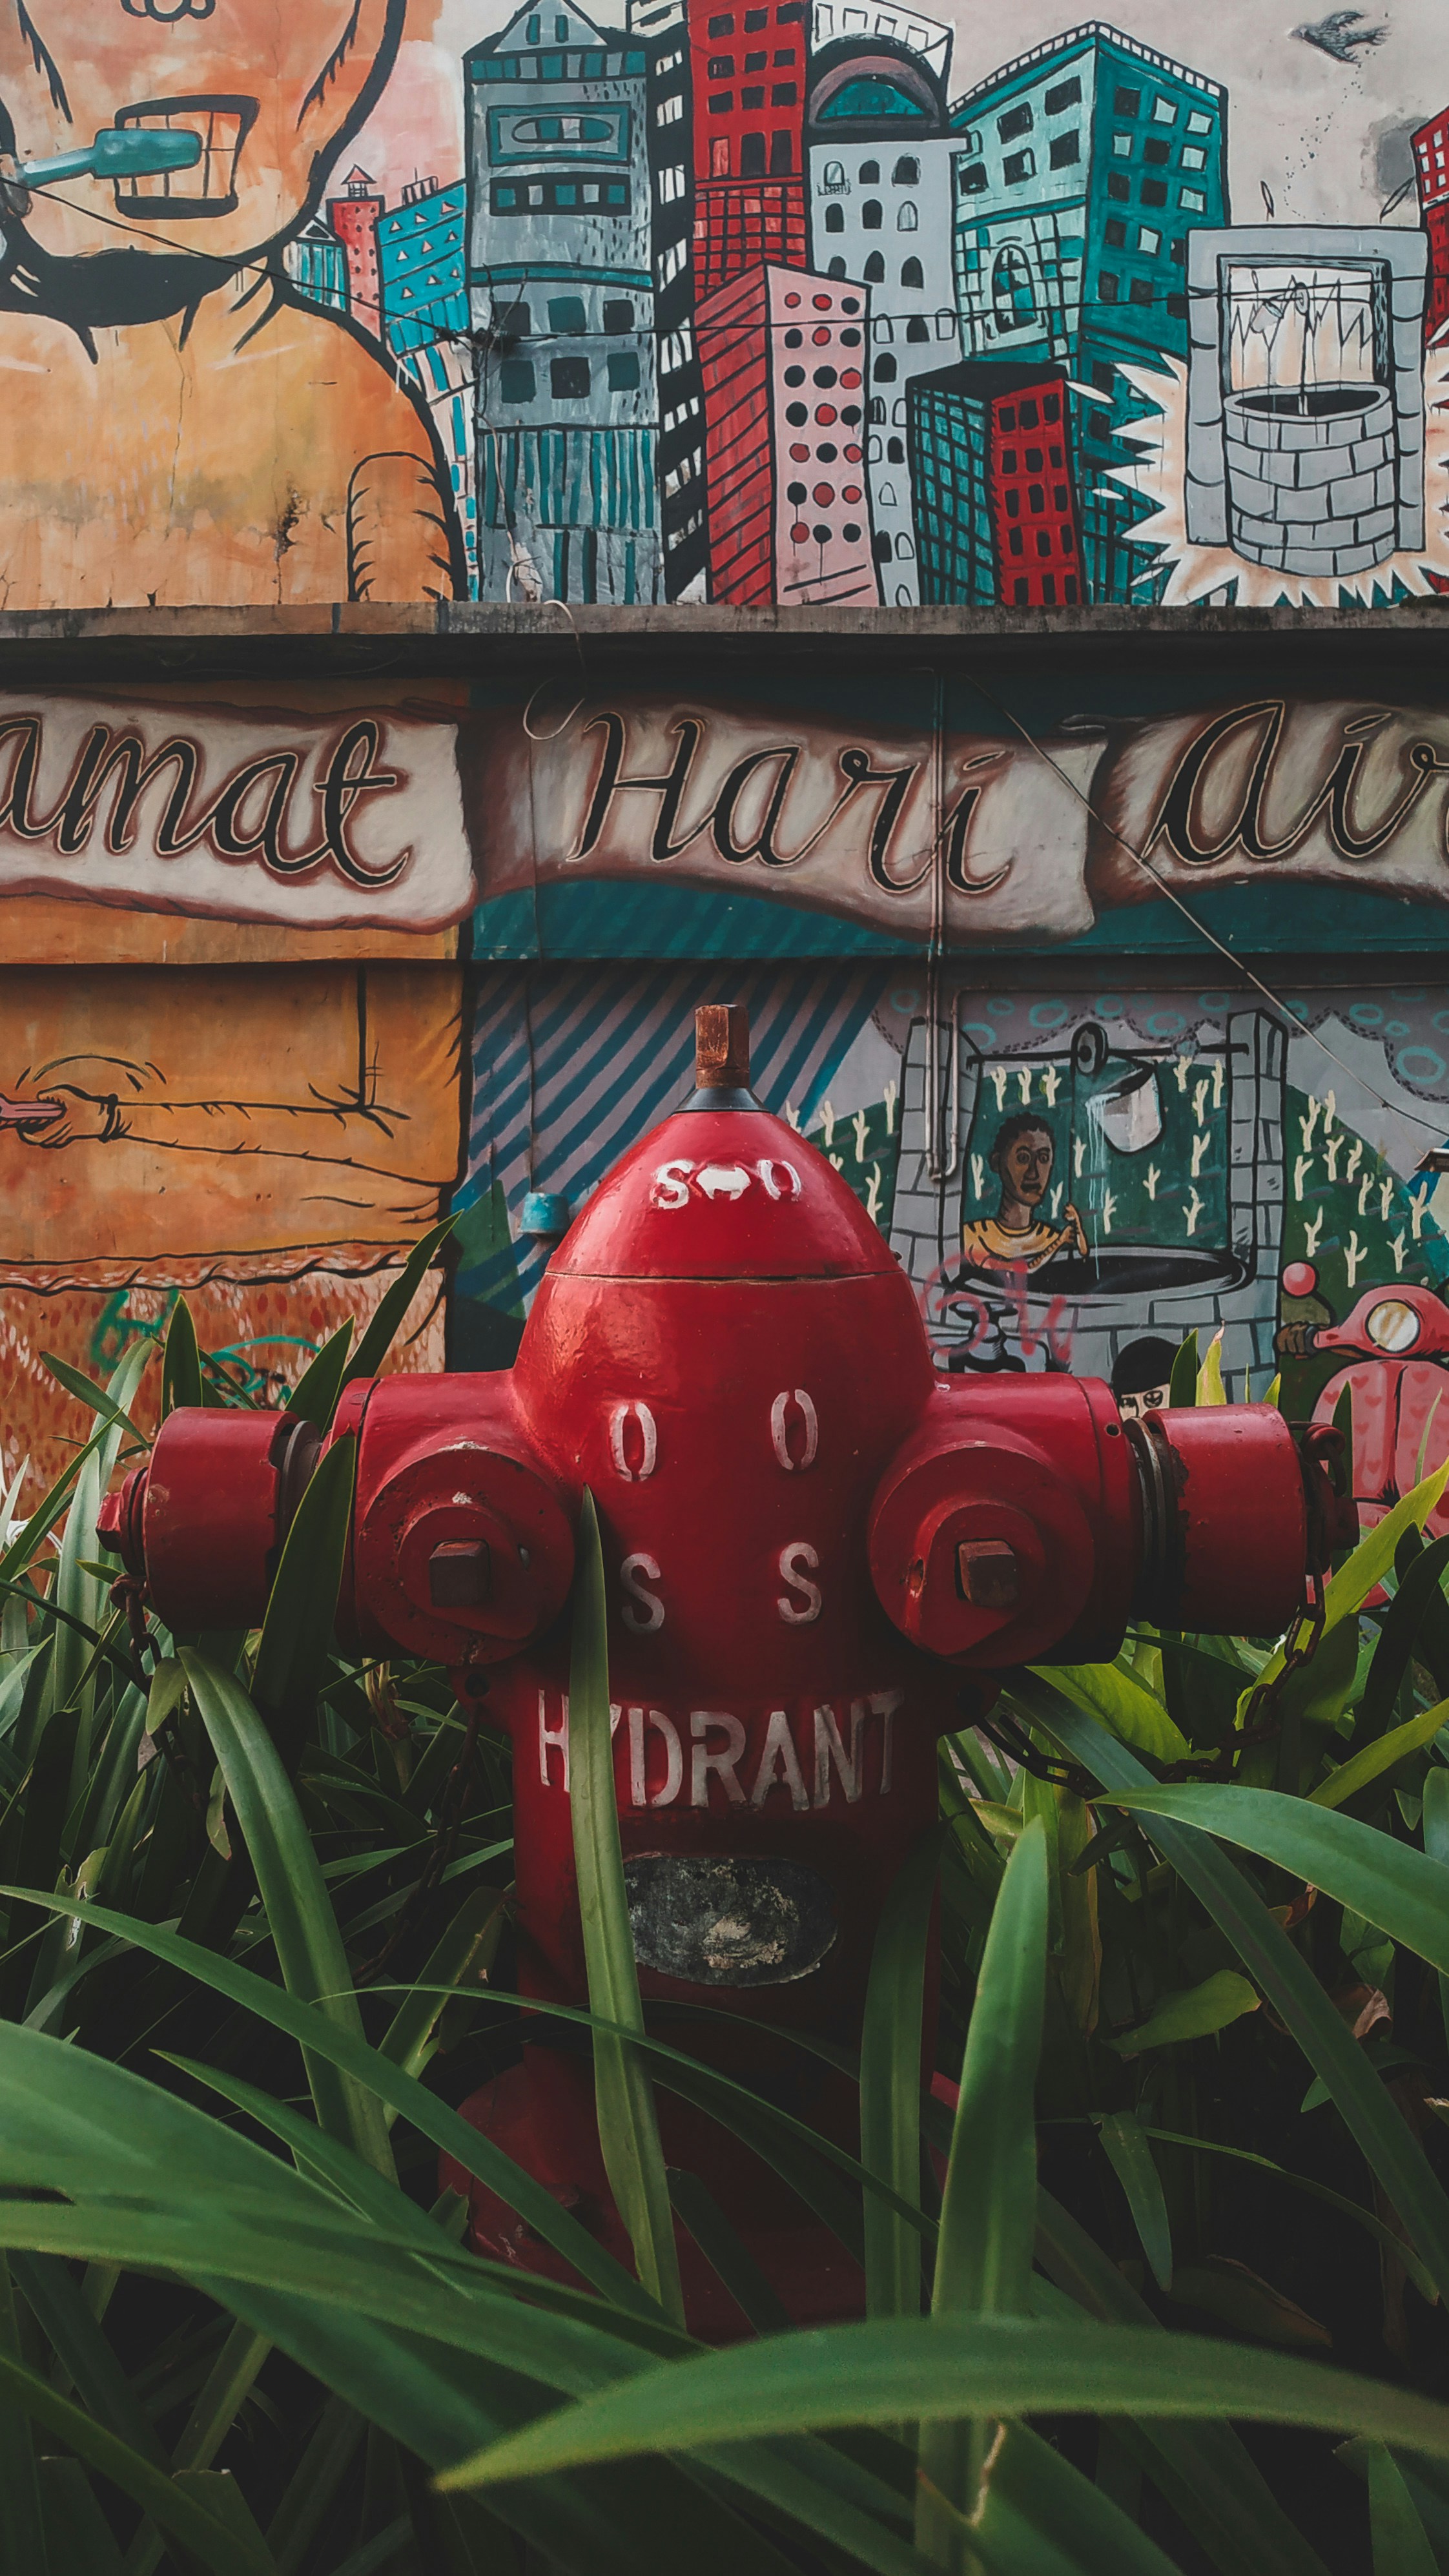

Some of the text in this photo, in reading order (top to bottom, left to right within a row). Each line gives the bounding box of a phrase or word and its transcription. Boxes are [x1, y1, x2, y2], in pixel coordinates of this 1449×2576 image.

[566, 711, 1012, 894] Hari
[650, 1159, 695, 1210] S
[620, 1541, 822, 1634] S S
